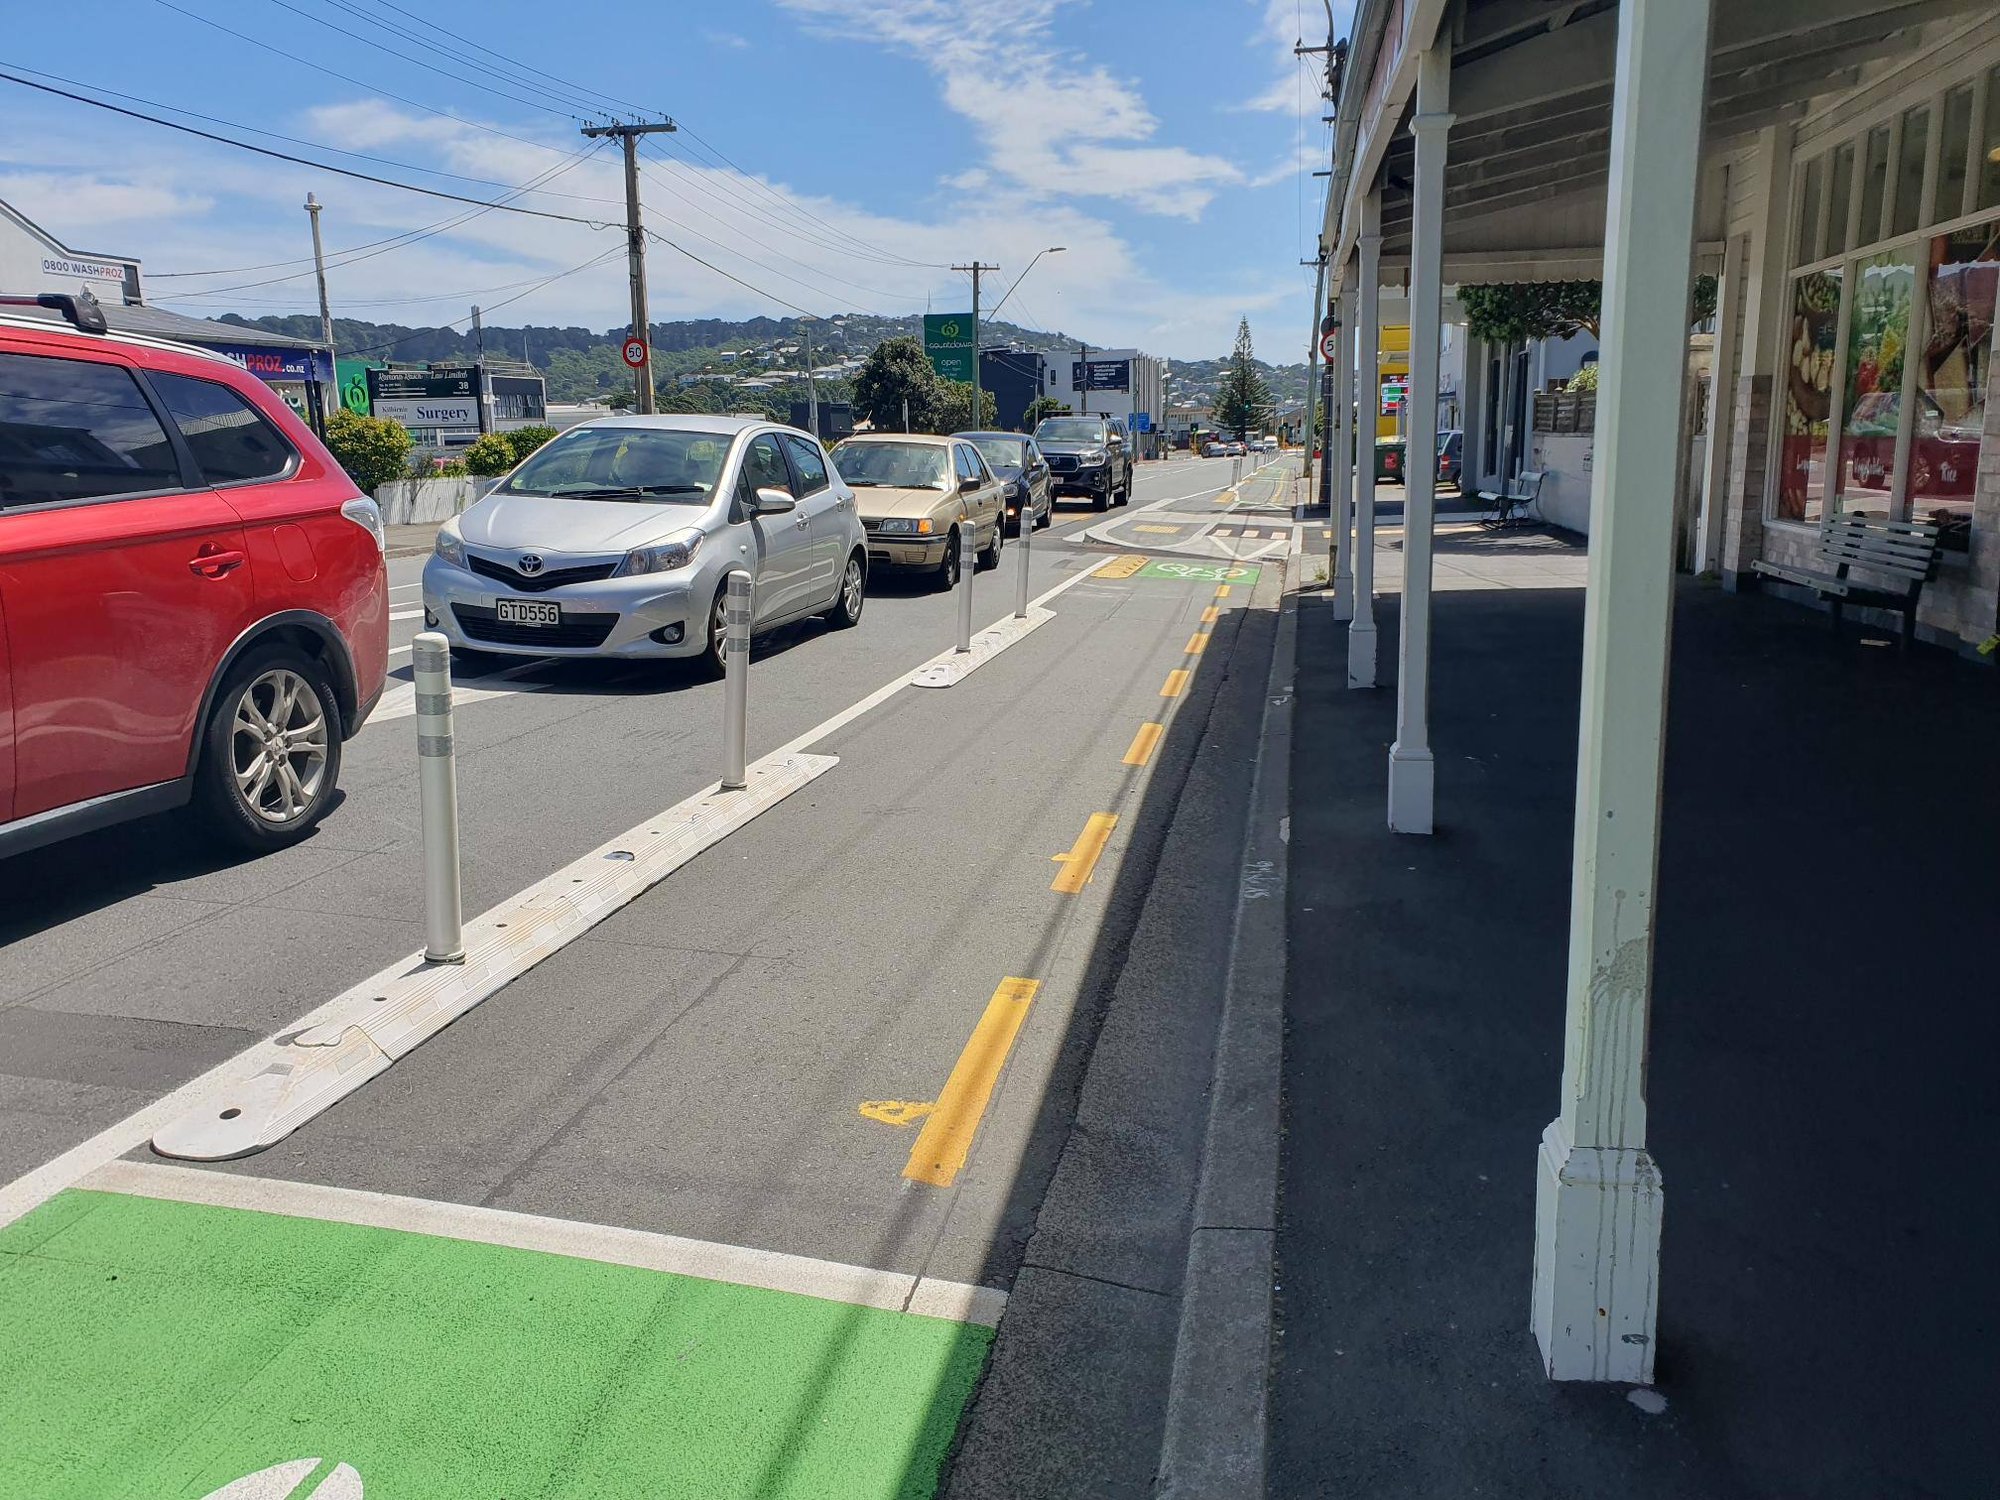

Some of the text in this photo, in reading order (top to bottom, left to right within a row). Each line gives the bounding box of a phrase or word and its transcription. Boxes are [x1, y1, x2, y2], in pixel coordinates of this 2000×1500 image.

[43, 260, 123, 279] 0800 WASHPROZ
[1327, 340, 1334, 351] 5
[628, 347, 642, 358] 50
[458, 381, 469, 390] 38
[416, 406, 469, 422] Surgery
[499, 603, 557, 622] GTD556
